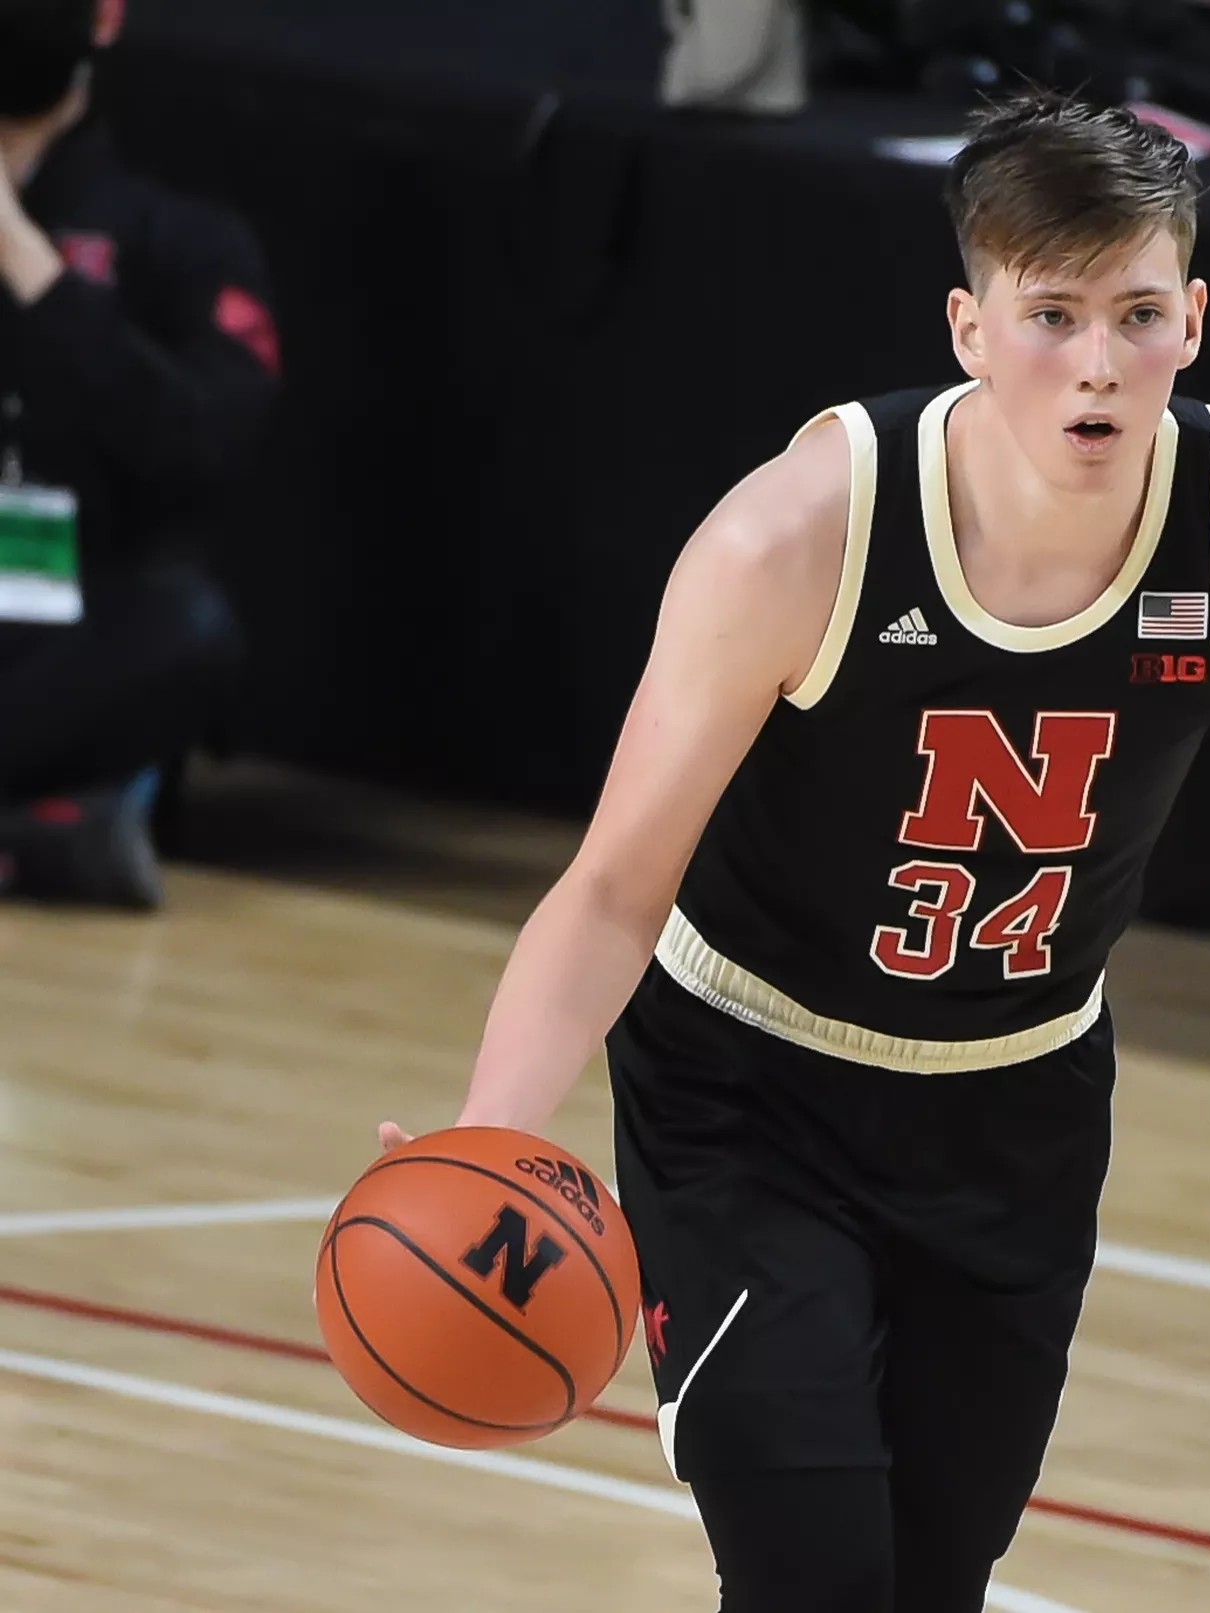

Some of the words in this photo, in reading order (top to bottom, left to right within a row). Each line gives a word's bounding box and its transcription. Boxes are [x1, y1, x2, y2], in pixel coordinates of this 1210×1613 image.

[878, 629, 938, 646] adidas
[899, 709, 1116, 853] N
[869, 860, 1072, 980] 34
[515, 1158, 605, 1236] adidas
[460, 1202, 567, 1315] N
